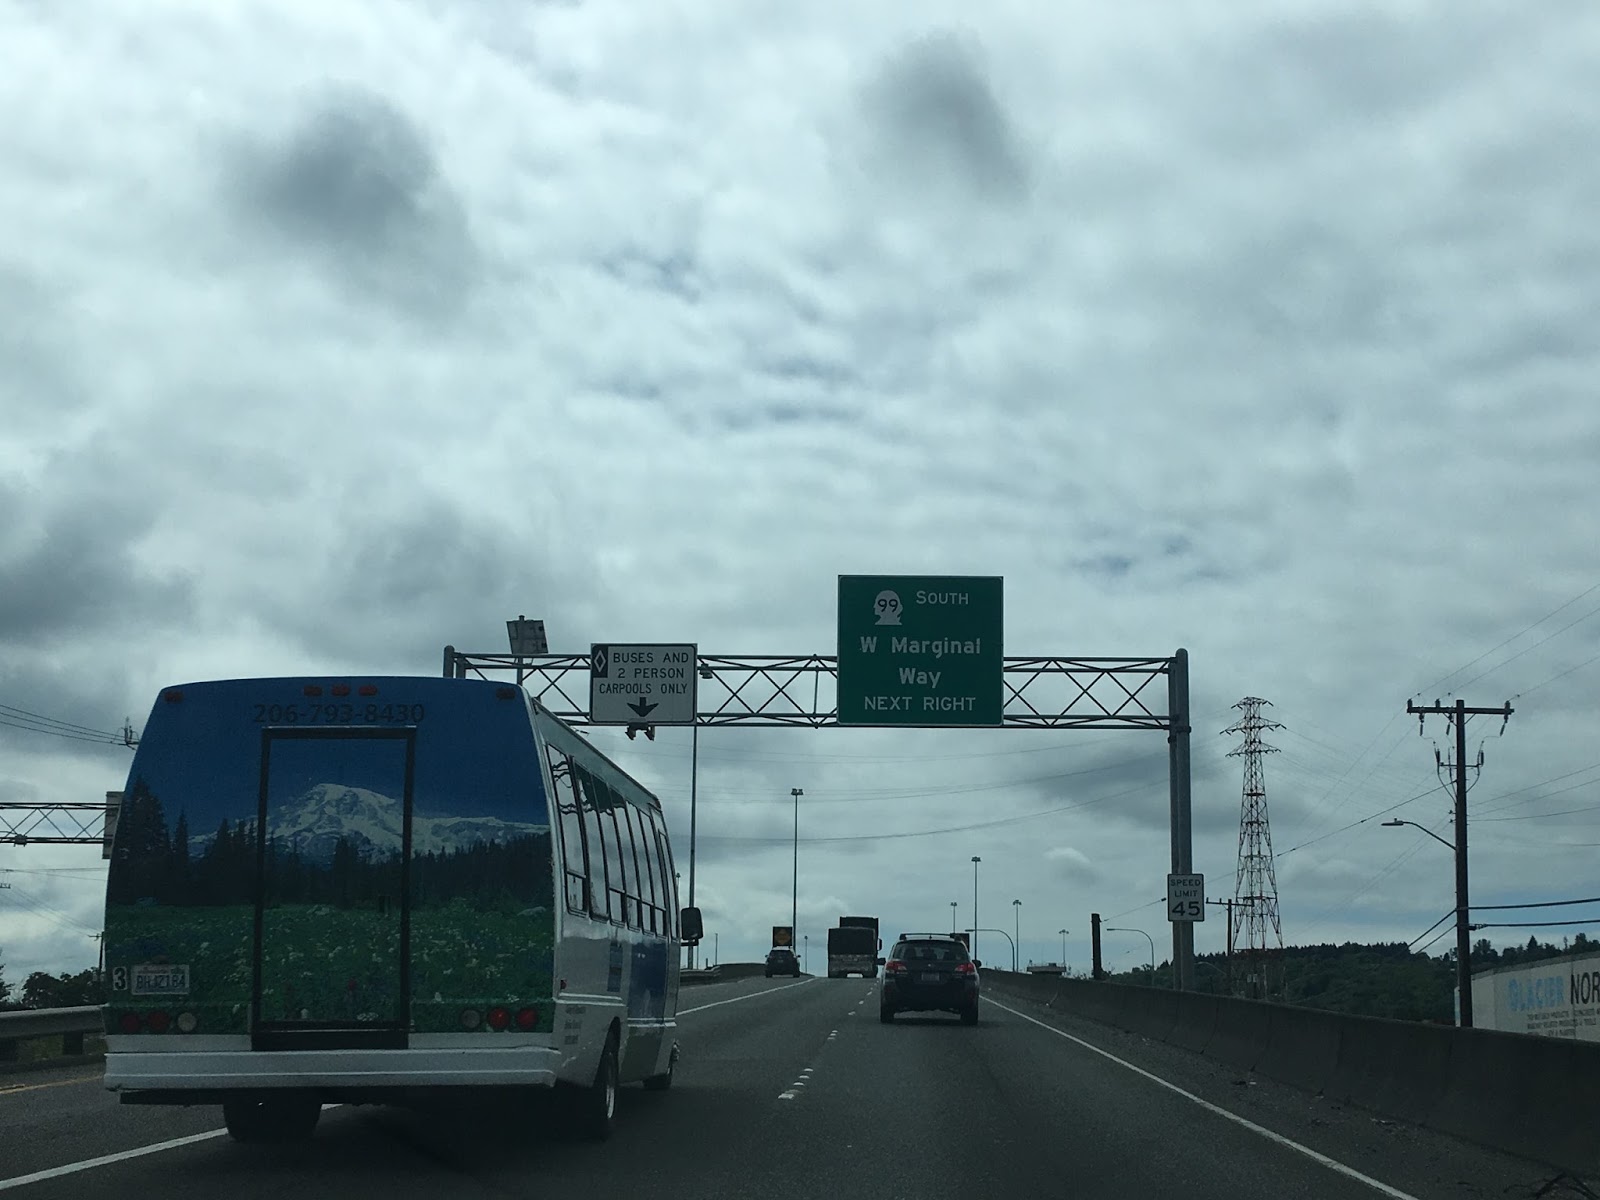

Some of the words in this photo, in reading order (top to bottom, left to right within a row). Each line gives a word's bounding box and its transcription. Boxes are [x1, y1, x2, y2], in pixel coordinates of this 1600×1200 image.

[877, 599, 898, 613] 99
[860, 636, 877, 653] W
[891, 637, 981, 659] Marginal
[613, 652, 654, 663] BUSES
[662, 652, 689, 663] AND
[617, 667, 626, 679] 2
[634, 667, 684, 679] PERSON
[899, 668, 941, 689] Way
[599, 683, 652, 694] CARPOOLS
[660, 683, 688, 694] ONLY
[864, 696, 912, 711] NEXT
[923, 697, 976, 711] RIGHT
[253, 703, 425, 723] 206-793-8430
[1170, 878, 1201, 887] SPEED
[1174, 890, 1198, 898] LIMIT
[1171, 901, 1201, 917] 45
[114, 967, 126, 990] 3
